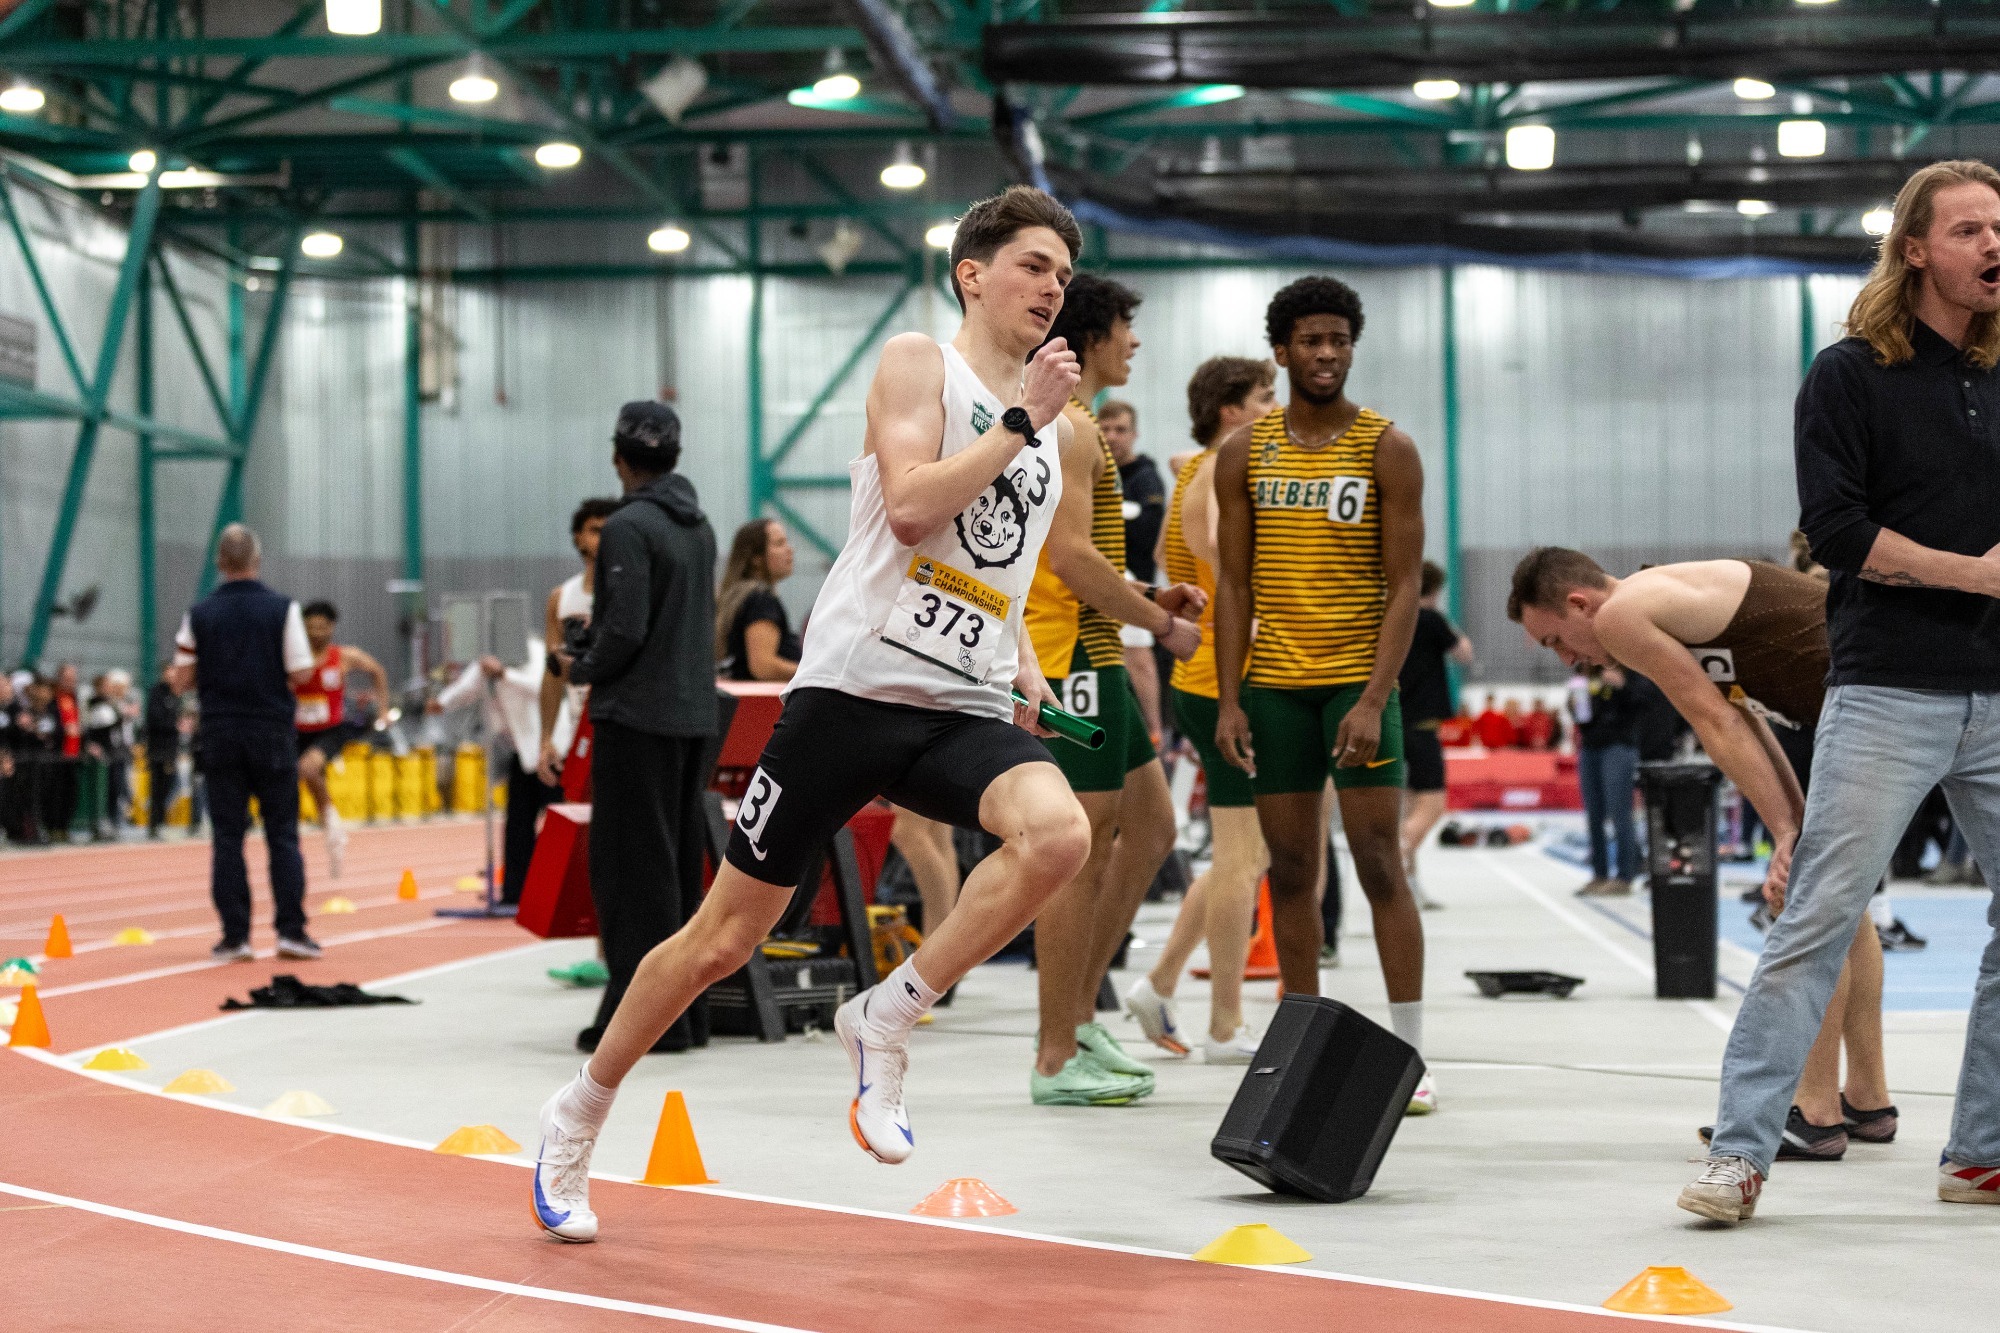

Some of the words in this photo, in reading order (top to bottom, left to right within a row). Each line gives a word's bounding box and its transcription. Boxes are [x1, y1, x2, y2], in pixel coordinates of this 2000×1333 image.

[1027, 455, 1051, 507] 3
[1256, 480, 1331, 508] ALBER
[1337, 480, 1360, 522] 6
[934, 578, 1003, 617] CHAMPIONSHIPS
[939, 569, 970, 589] TRACK
[981, 590, 1006, 608] FIELD
[914, 593, 985, 648] 373
[1071, 674, 1091, 715] 6
[740, 775, 772, 831] 3
